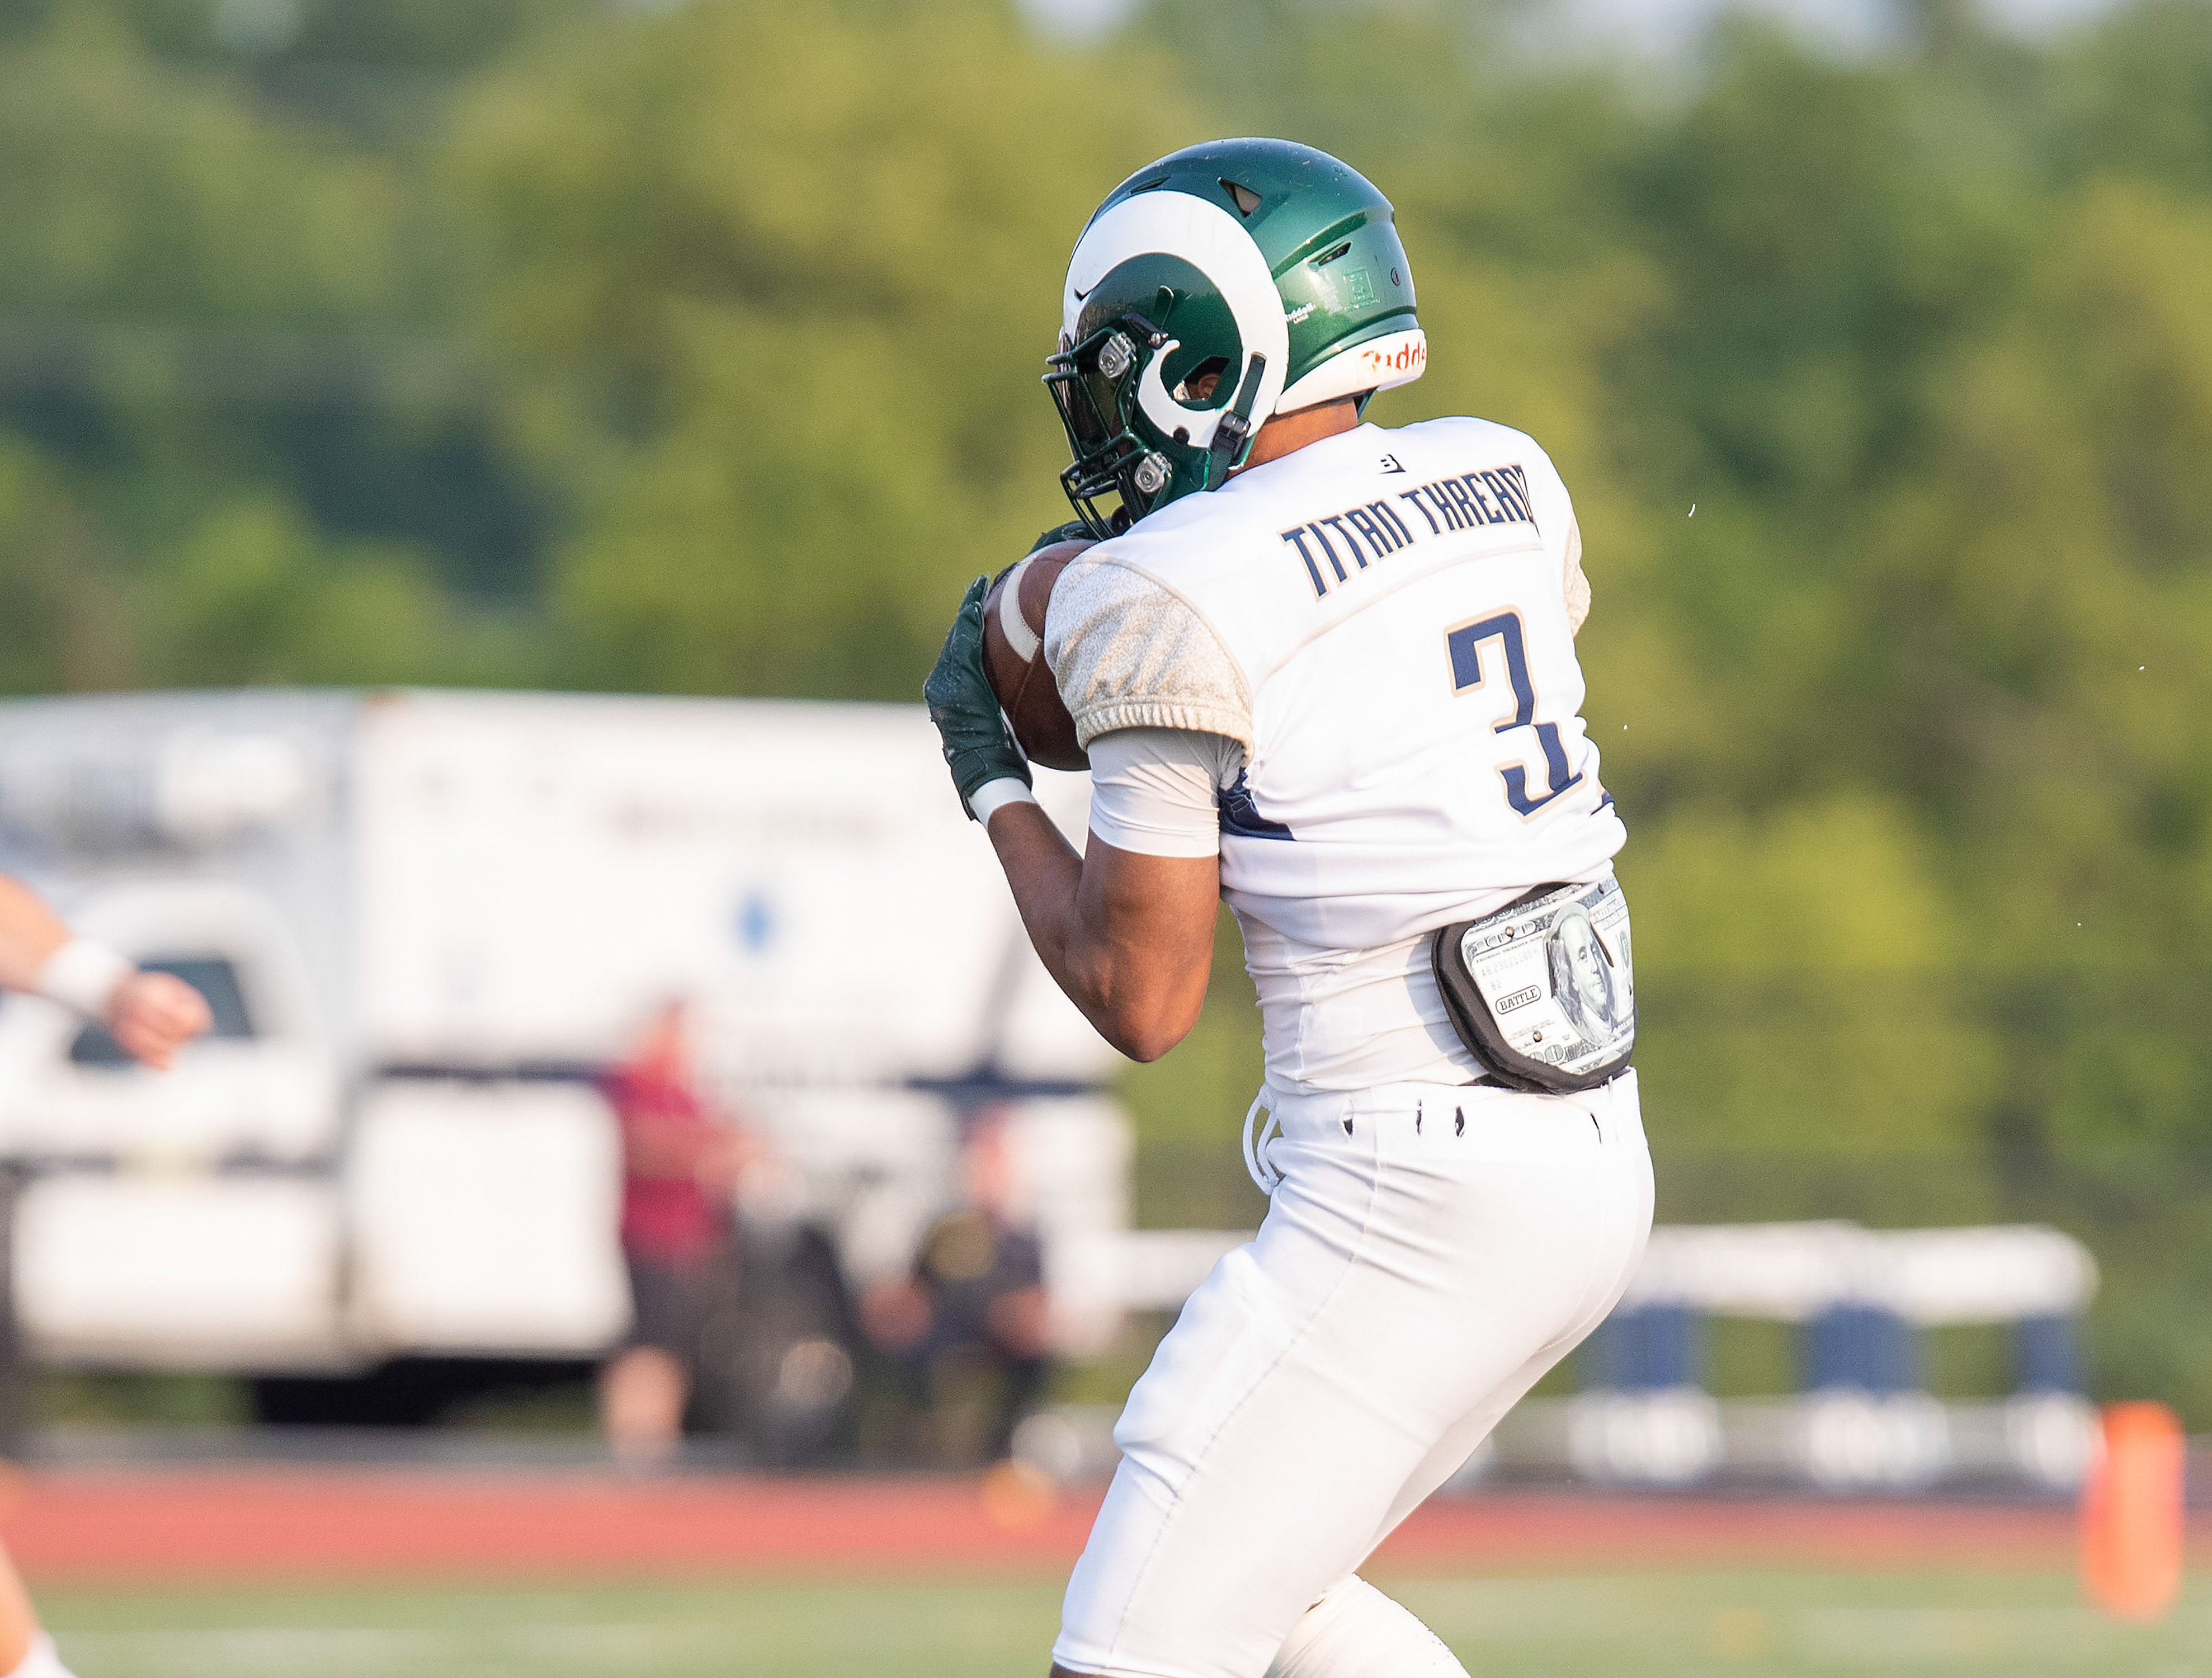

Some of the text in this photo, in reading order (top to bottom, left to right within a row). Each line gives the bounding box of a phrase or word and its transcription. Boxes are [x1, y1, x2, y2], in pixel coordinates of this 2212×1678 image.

[1277, 498, 1417, 602] TITAN
[1444, 604, 1587, 825] 3
[1499, 988, 1537, 1011] BATTLE
